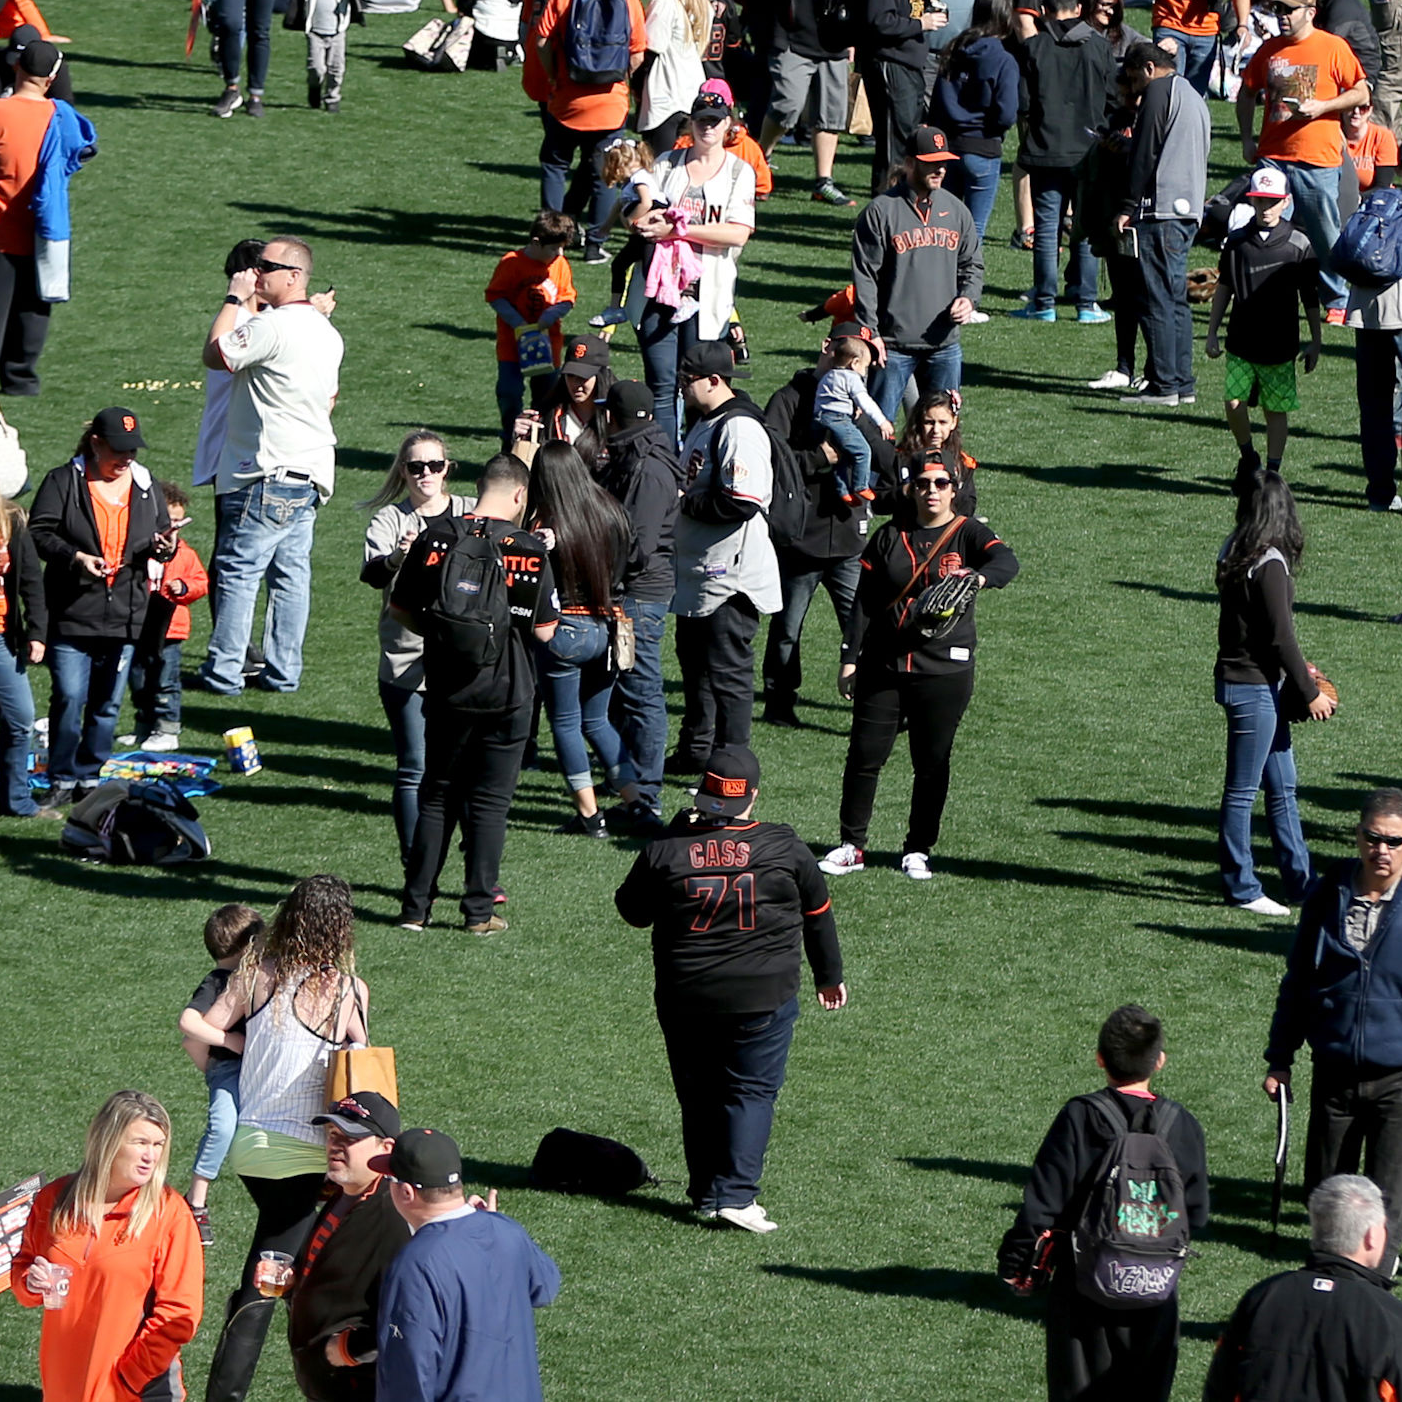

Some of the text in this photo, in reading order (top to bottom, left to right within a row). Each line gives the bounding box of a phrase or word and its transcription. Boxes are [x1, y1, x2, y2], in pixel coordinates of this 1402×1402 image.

[892, 228, 960, 255] GIANTS
[509, 606, 533, 618] CSN
[688, 838, 751, 871] CASS
[686, 873, 757, 933] 71
